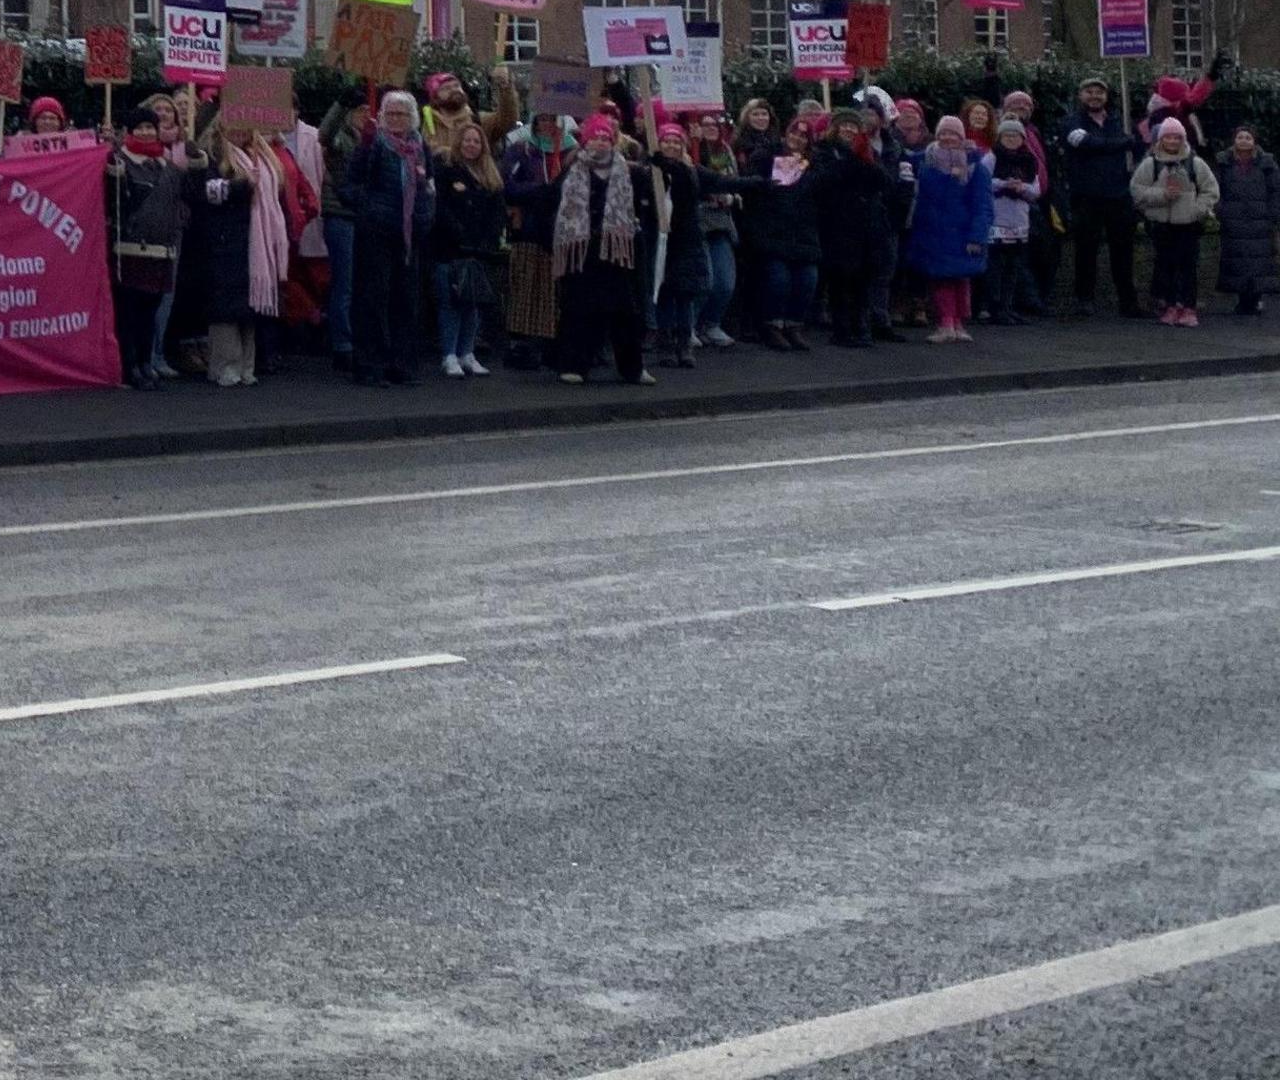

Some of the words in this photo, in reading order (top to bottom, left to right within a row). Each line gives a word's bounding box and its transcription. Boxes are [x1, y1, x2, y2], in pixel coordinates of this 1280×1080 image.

[169, 36, 221, 52] OFFICIAL
[168, 48, 221, 65] DISPUTE
[9, 180, 85, 253] POWER
[10, 311, 89, 338] EDUCATION
